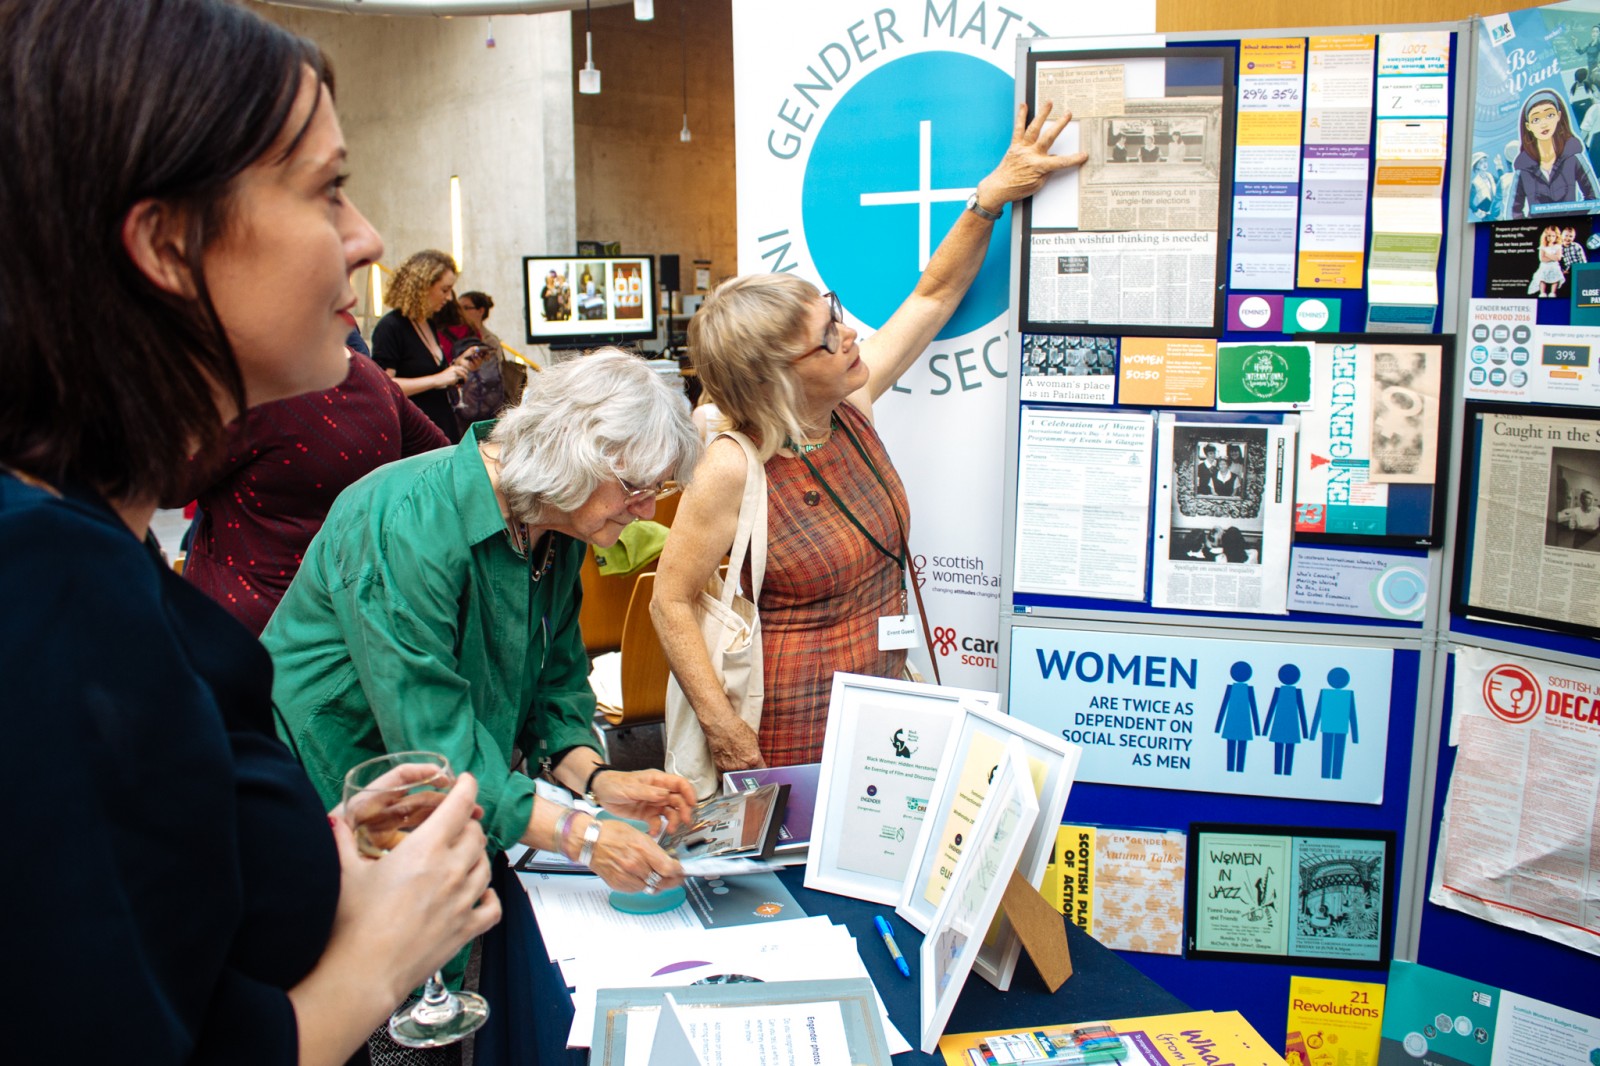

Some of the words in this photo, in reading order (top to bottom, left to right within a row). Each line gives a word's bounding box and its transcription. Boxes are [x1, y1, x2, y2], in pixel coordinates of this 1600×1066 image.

[1402, 43, 1428, 54] 2007
[1506, 47, 1538, 75] Be
[1504, 57, 1561, 96] Want
[767, 7, 904, 160] GENDER
[1242, 88, 1268, 100] 29%
[1271, 88, 1298, 100] 35%
[1111, 189, 1140, 197] Women
[1142, 188, 1168, 199] missing
[1170, 188, 1184, 197] out
[1188, 188, 1197, 196] in
[1305, 189, 1316, 201] 2.
[1116, 196, 1154, 206] single-tier
[1156, 196, 1190, 205] elections
[1235, 226, 1247, 238] 2.
[1303, 223, 1315, 235] 3.
[1054, 234, 1076, 245] than
[1079, 234, 1115, 244] wishful
[1117, 233, 1159, 245] thinking
[1162, 234, 1170, 243] is
[1172, 232, 1209, 243] needed
[1234, 262, 1246, 273] 3.
[1582, 289, 1599, 297] CLOSE
[1298, 311, 1327, 319] FEMINIST
[1475, 304, 1500, 312] GENDER
[1500, 305, 1531, 313] MATTERS:
[1474, 313, 1513, 321] HOLYROOD
[1514, 313, 1531, 321] 2016
[1123, 354, 1164, 366] WOMEN
[1554, 350, 1576, 361] 39%
[1125, 369, 1160, 380] 50:50
[1025, 379, 1034, 387] A
[1036, 379, 1082, 388] woman's
[1083, 381, 1111, 391] place
[1029, 390, 1038, 398] is
[1039, 390, 1051, 399] in
[1052, 390, 1106, 401] Parliament
[1040, 419, 1093, 429] Celebration
[1112, 423, 1145, 431] Women
[1493, 421, 1544, 441] Caught
[1547, 425, 1561, 439] in
[1567, 427, 1590, 442] the
[1027, 434, 1066, 442] Programme
[932, 555, 984, 571] scottish
[932, 570, 989, 588] women's
[931, 586, 954, 595] changing
[953, 587, 976, 596] attitudes
[976, 590, 999, 599] changing
[901, 628, 915, 636] Guest
[1035, 648, 1198, 689] WOMEN
[1548, 675, 1592, 694] SCOTTISH
[1088, 695, 1119, 711] ARE
[1122, 697, 1171, 715] TWICE
[1174, 701, 1194, 716] AS
[1073, 712, 1168, 733] DEPENDENT
[1169, 719, 1193, 734] ON
[1061, 729, 1115, 747] SOCIAL
[1119, 733, 1193, 752] SECURITY
[1132, 752, 1152, 766] AS
[1156, 754, 1191, 770] MEN
[871, 766, 889, 775] Evening
[1064, 850, 1075, 868] OF
[1102, 850, 1147, 862] Autumn
[1150, 851, 1179, 864] Talks
[1210, 850, 1262, 866] WOMEN
[1078, 833, 1089, 895] SCOTTISH
[1218, 868, 1232, 882] IN
[1208, 885, 1246, 902] JAZZ
[1350, 990, 1370, 1004] 21
[1293, 999, 1379, 1018] Revolutions
[1513, 1005, 1533, 1016] Scottish
[1554, 1016, 1572, 1028] Budget
[1572, 1023, 1589, 1033] Group
[806, 1016, 818, 1043] Engender
[810, 1044, 821, 1066] photos
